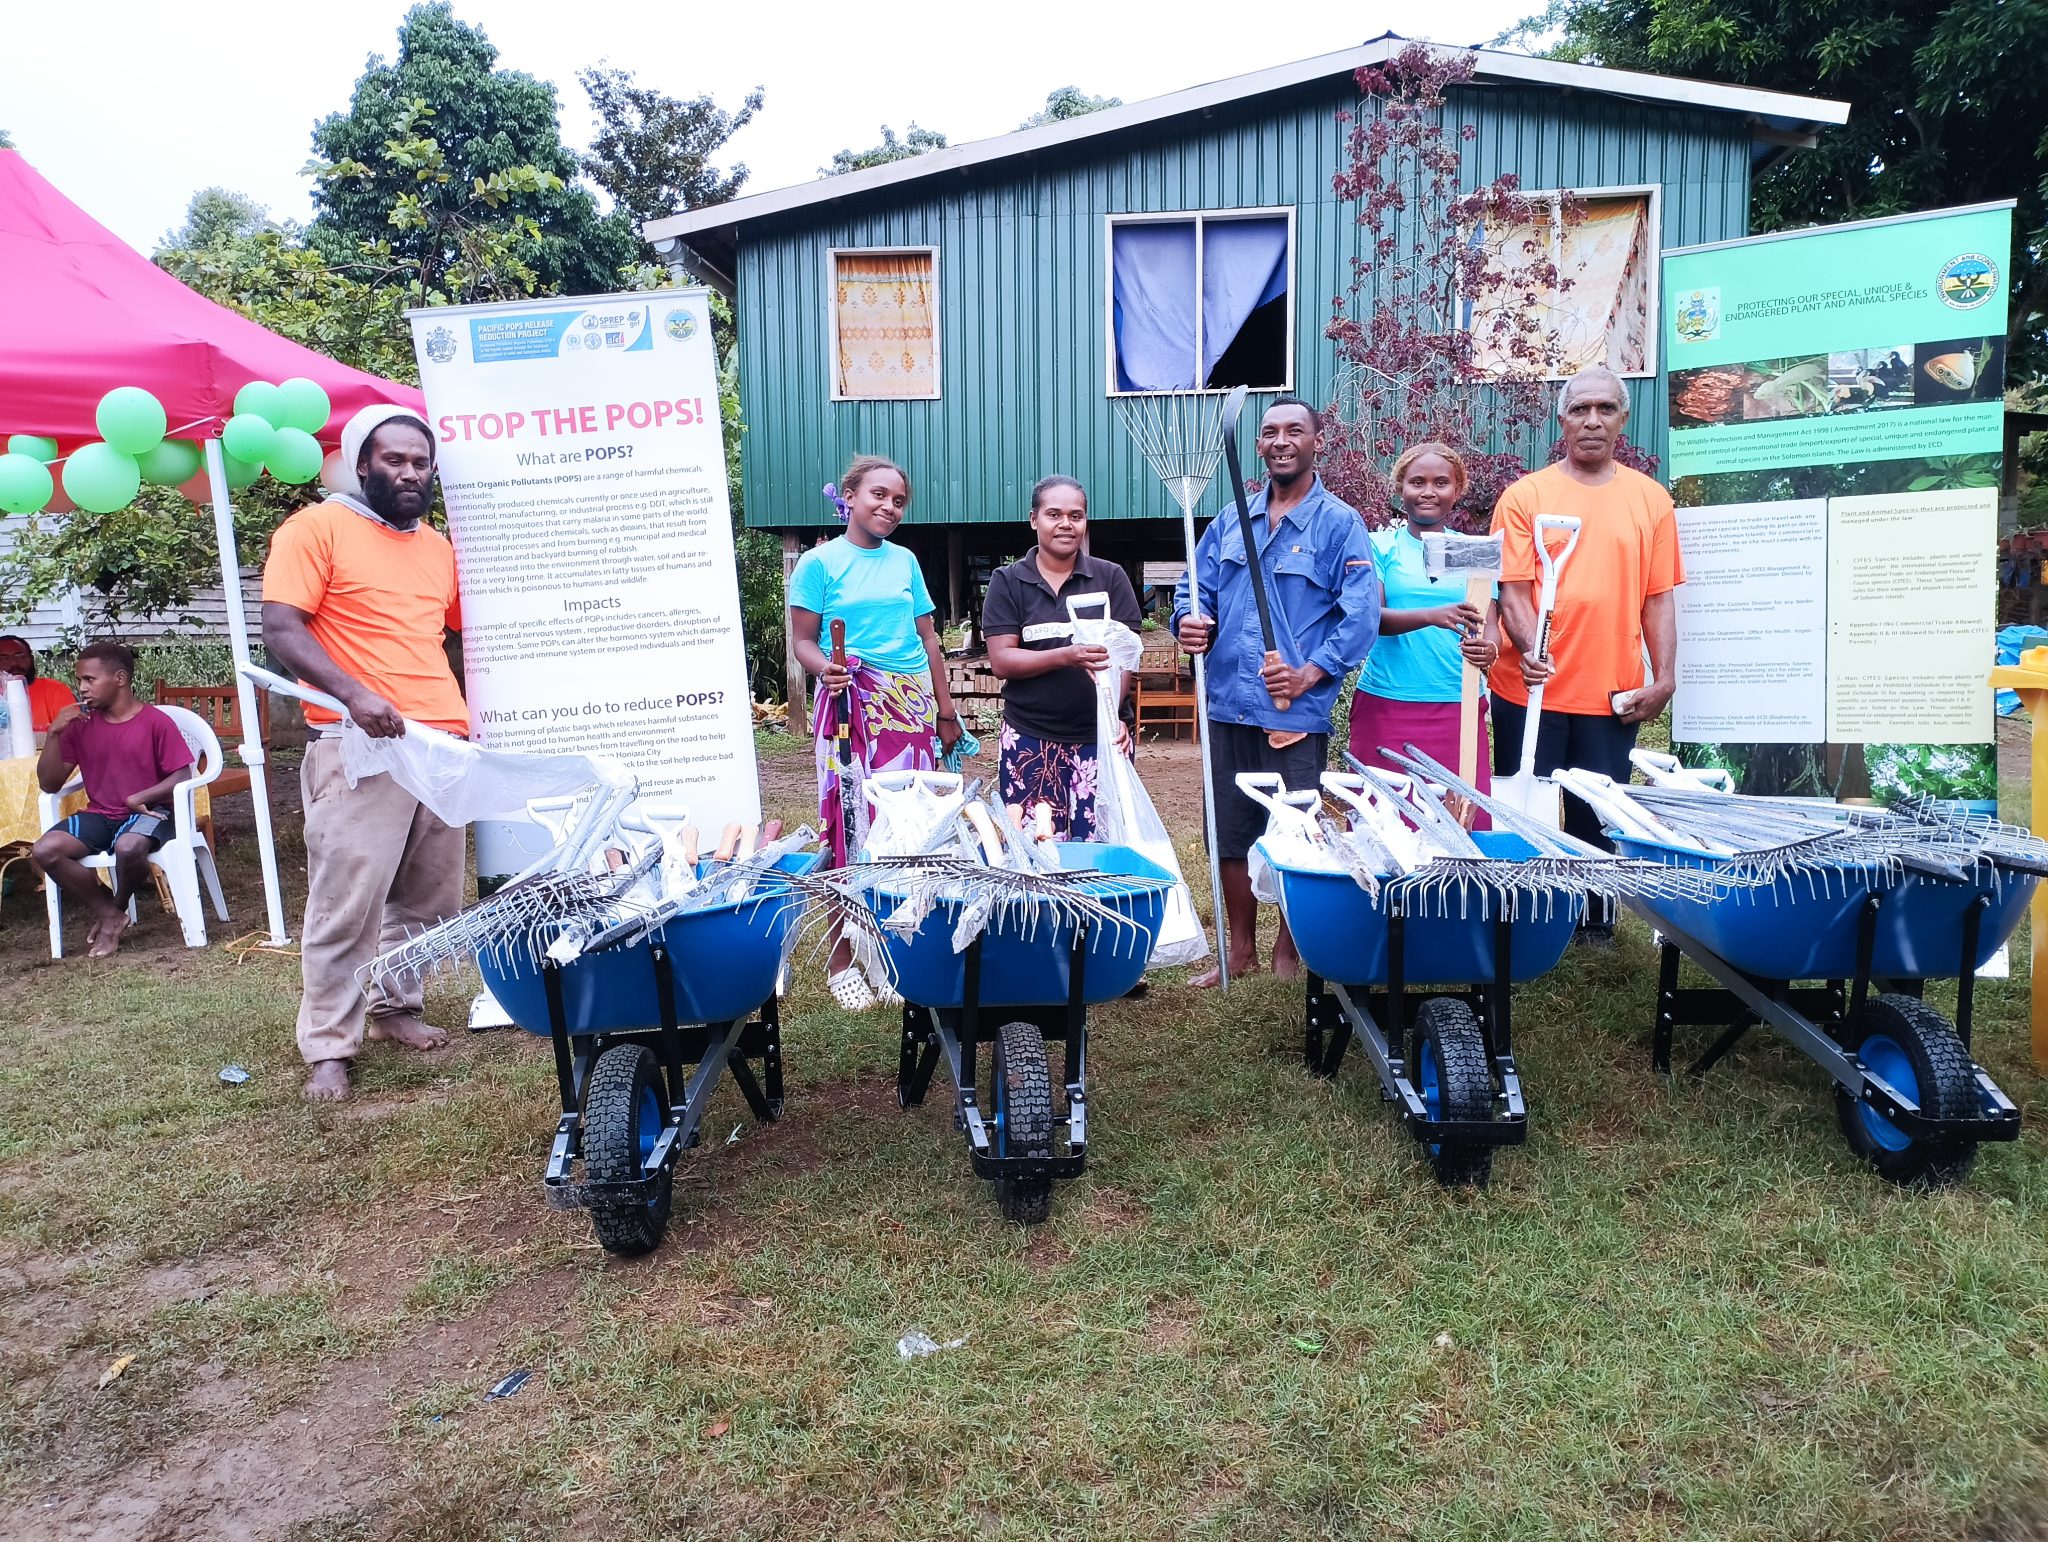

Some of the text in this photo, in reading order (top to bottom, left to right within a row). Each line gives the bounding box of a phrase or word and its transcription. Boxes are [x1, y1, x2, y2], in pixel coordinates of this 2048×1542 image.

[1938, 258, 1960, 302] ENVIRONMENT
[1725, 290, 1928, 322] ENDANGERED PLANT AND ANIMAL SPECIES
[1737, 282, 1913, 312] PROTECTING OUR SPECIAL, UNIQUE &
[478, 320, 555, 333] PACIFIC POPS RELEASE
[599, 316, 624, 325] SPREP
[479, 329, 548, 341] REDUCTION PROJECT
[439, 398, 704, 442] STOP THE POPS!
[1687, 437, 1709, 446] Wildlife
[1710, 435, 1742, 443] Protection
[1757, 430, 1799, 441] Management
[1878, 421, 1896, 430] 2017)
[1910, 418, 1938, 426] national
[1708, 447, 1730, 455] control
[1739, 443, 1779, 452] international
[1799, 437, 1849, 449] (import/export)
[1859, 434, 1883, 444] special,
[1884, 432, 1908, 441] unique
[1924, 428, 1966, 438] endangered
[1968, 426, 1986, 435] plant
[1738, 456, 1761, 465] species
[1782, 451, 1811, 460] Solomon
[1872, 443, 1917, 453] administered
[1918, 442, 1926, 450] by
[516, 445, 633, 467] What are POPS?
[477, 480, 510, 491] Organic
[511, 476, 553, 486] Pollutants
[554, 474, 582, 485] (POPS)
[603, 472, 624, 482] range
[635, 468, 664, 477] harmful
[666, 465, 703, 475] chemicals
[498, 499, 535, 511] produced
[536, 496, 574, 506] chemicals
[575, 494, 608, 505] currently
[640, 489, 658, 498] used
[668, 485, 710, 498] agriculture,
[563, 596, 621, 614] Impacts
[474, 622, 507, 633] example
[518, 619, 547, 630] specific
[549, 617, 574, 626] effects
[585, 615, 604, 623] POPs
[606, 612, 637, 621] includes
[638, 611, 668, 619] cancers,
[669, 607, 702, 618] allergies,
[480, 691, 724, 724] What can you do to reduce POPS?
[486, 730, 504, 741] Stop
[504, 727, 536, 739] burning
[547, 724, 571, 736] plastic
[573, 722, 591, 733] bags
[592, 720, 616, 729] which
[616, 718, 646, 727] releases
[648, 715, 676, 725] harmful
[678, 712, 719, 722] substances
[487, 741, 502, 749] that
[526, 737, 547, 748] good
[558, 734, 585, 743] human
[586, 731, 611, 740] health
[612, 730, 627, 738] and
[628, 726, 676, 736] environment
[576, 743, 599, 752] buses
[600, 741, 618, 750] from
[620, 738, 654, 750] travelling
[667, 736, 680, 744] the
[681, 734, 698, 742] road
[709, 731, 726, 742] help
[616, 749, 646, 758] Honiara
[647, 748, 661, 758] City
